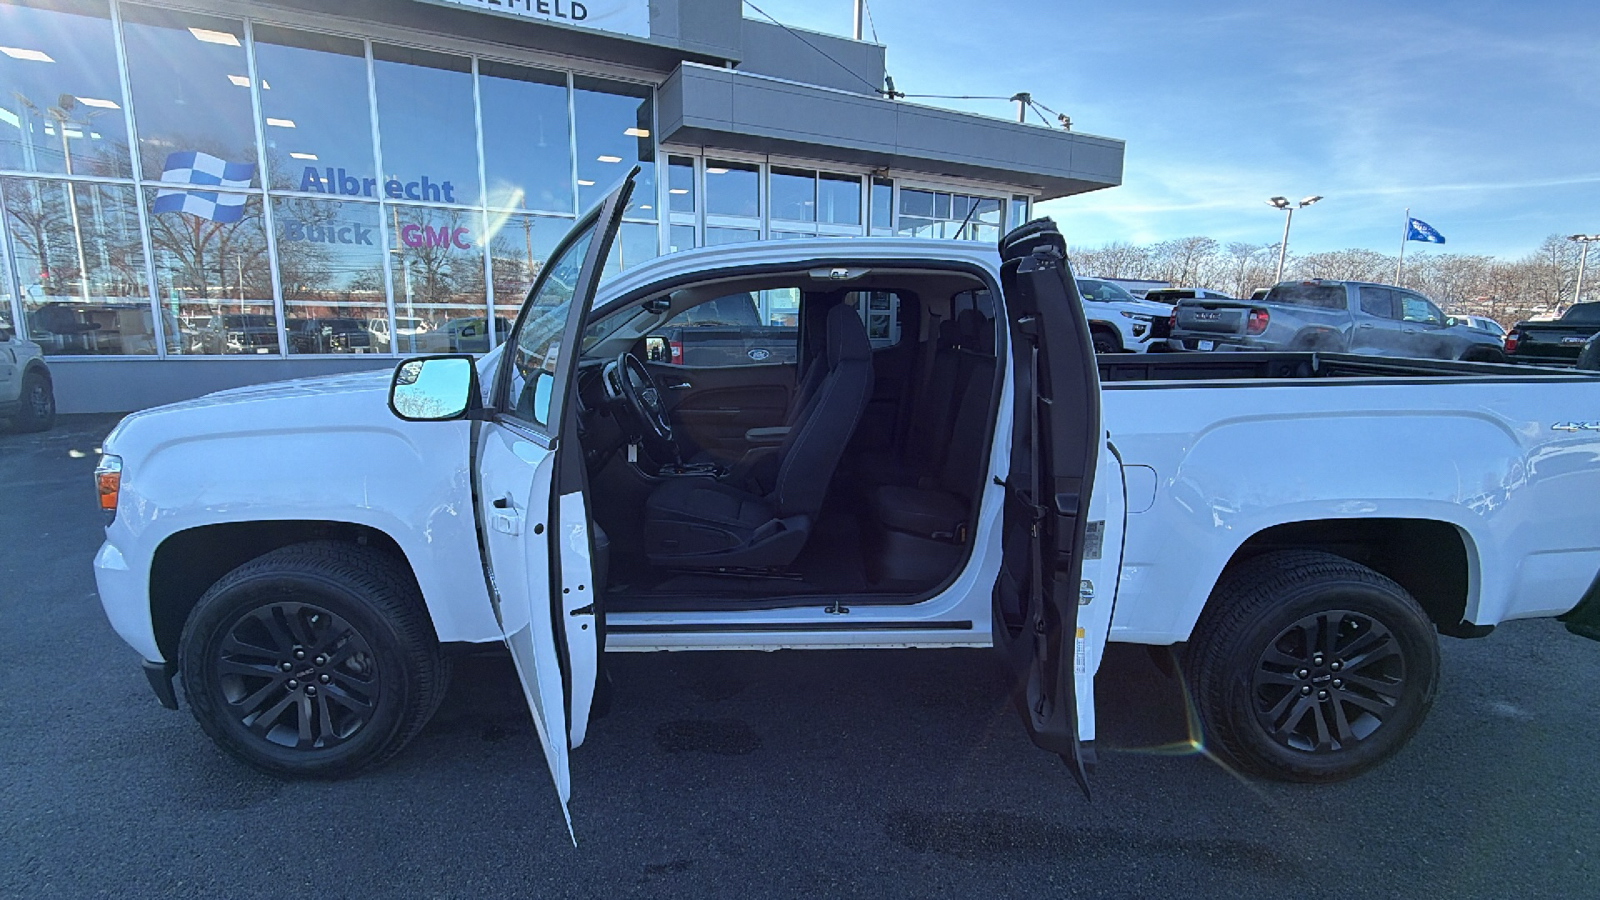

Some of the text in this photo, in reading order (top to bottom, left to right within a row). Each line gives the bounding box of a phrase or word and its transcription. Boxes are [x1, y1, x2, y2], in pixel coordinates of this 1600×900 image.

[477, 0, 588, 21] IELD
[299, 166, 455, 203] Albrecht
[283, 220, 471, 250] Buick GMC
